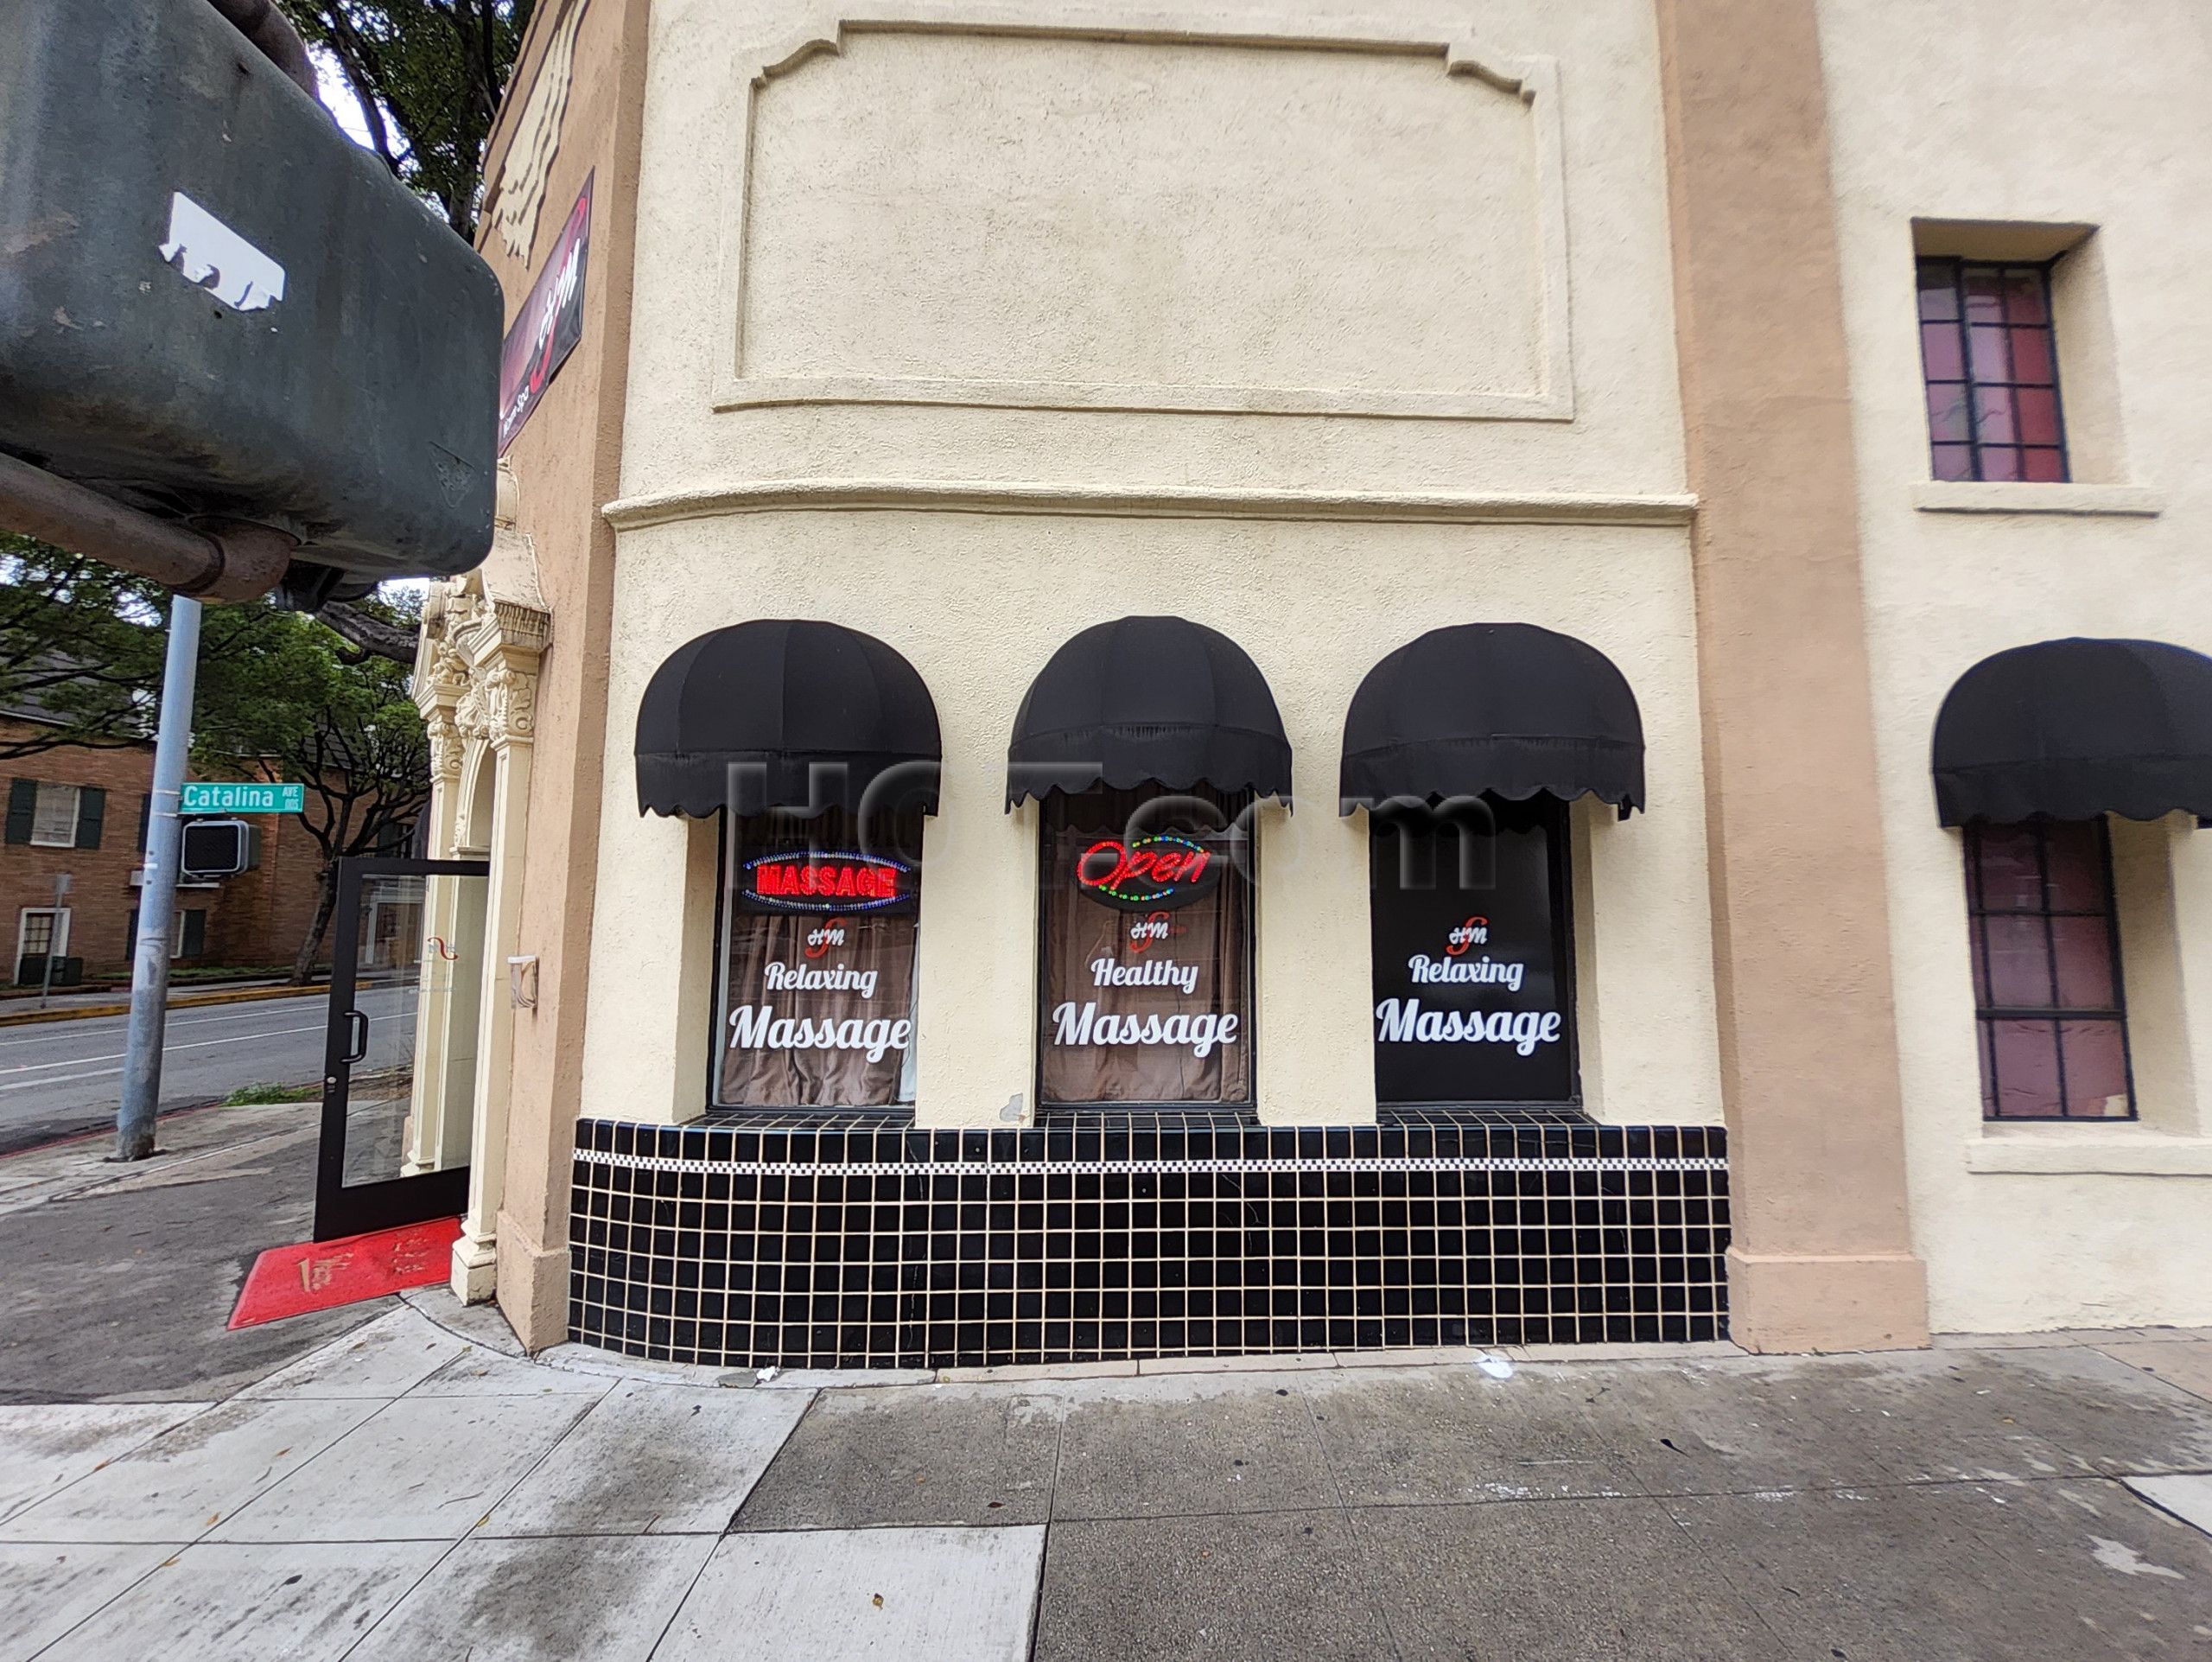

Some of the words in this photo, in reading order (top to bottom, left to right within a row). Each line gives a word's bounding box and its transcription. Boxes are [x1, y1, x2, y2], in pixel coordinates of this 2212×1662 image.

[183, 786, 275, 807] Catalina
[282, 786, 299, 797] AVE
[756, 864, 897, 898] MASSAGE
[1077, 840, 1211, 891] Open
[764, 961, 878, 999] Relaxing
[1090, 957, 1199, 995] Healthy
[1408, 954, 1524, 991] Relaxing
[728, 1004, 912, 1064] Massage
[1052, 1002, 1239, 1058] Massage
[1376, 997, 1561, 1056] Massage
